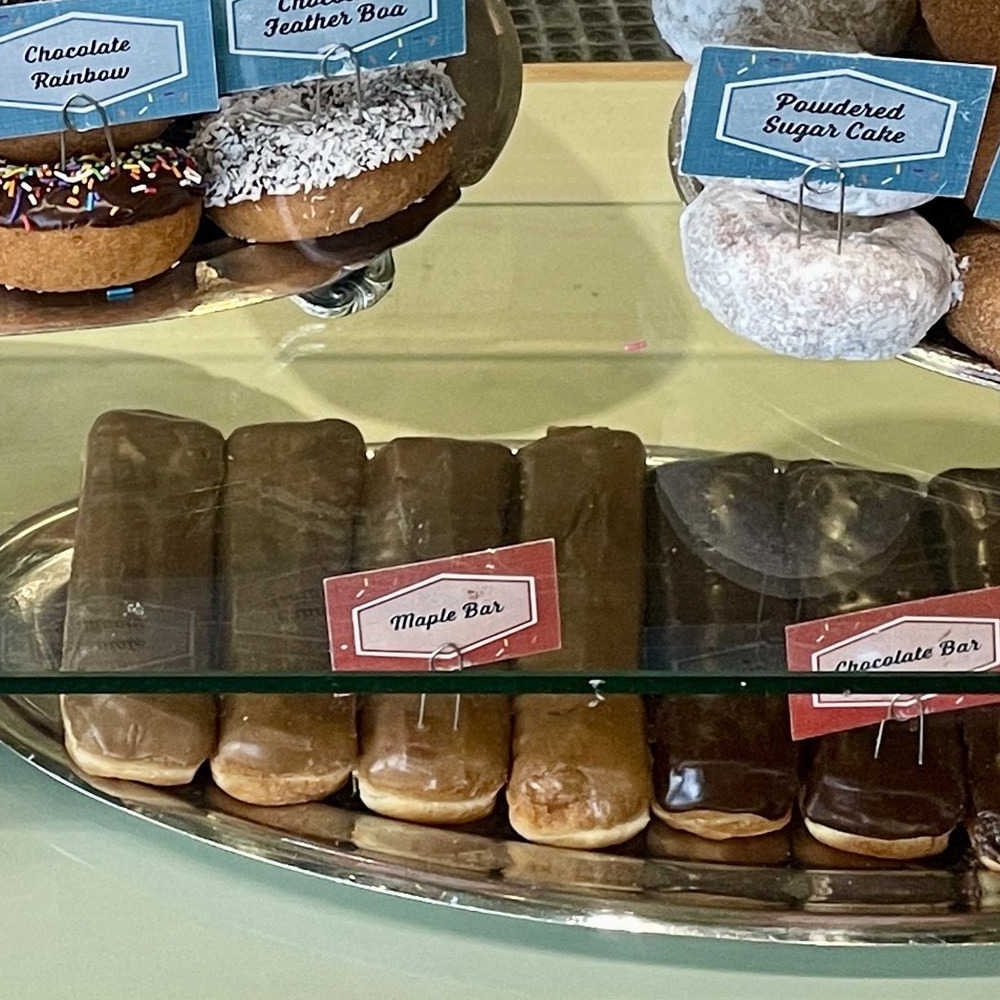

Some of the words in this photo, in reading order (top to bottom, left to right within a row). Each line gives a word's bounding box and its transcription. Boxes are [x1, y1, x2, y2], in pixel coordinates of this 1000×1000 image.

[263, 10, 352, 37] Feather
[357, 2, 408, 24] Boa
[24, 37, 131, 63] Chocolate
[31, 64, 130, 90] Rainbow
[776, 93, 905, 120] Powdered
[763, 115, 841, 142] Sugar
[846, 121, 906, 144] Cake
[390, 608, 456, 632] Maple
[462, 600, 504, 620] Bar
[939, 639, 981, 657] Bar
